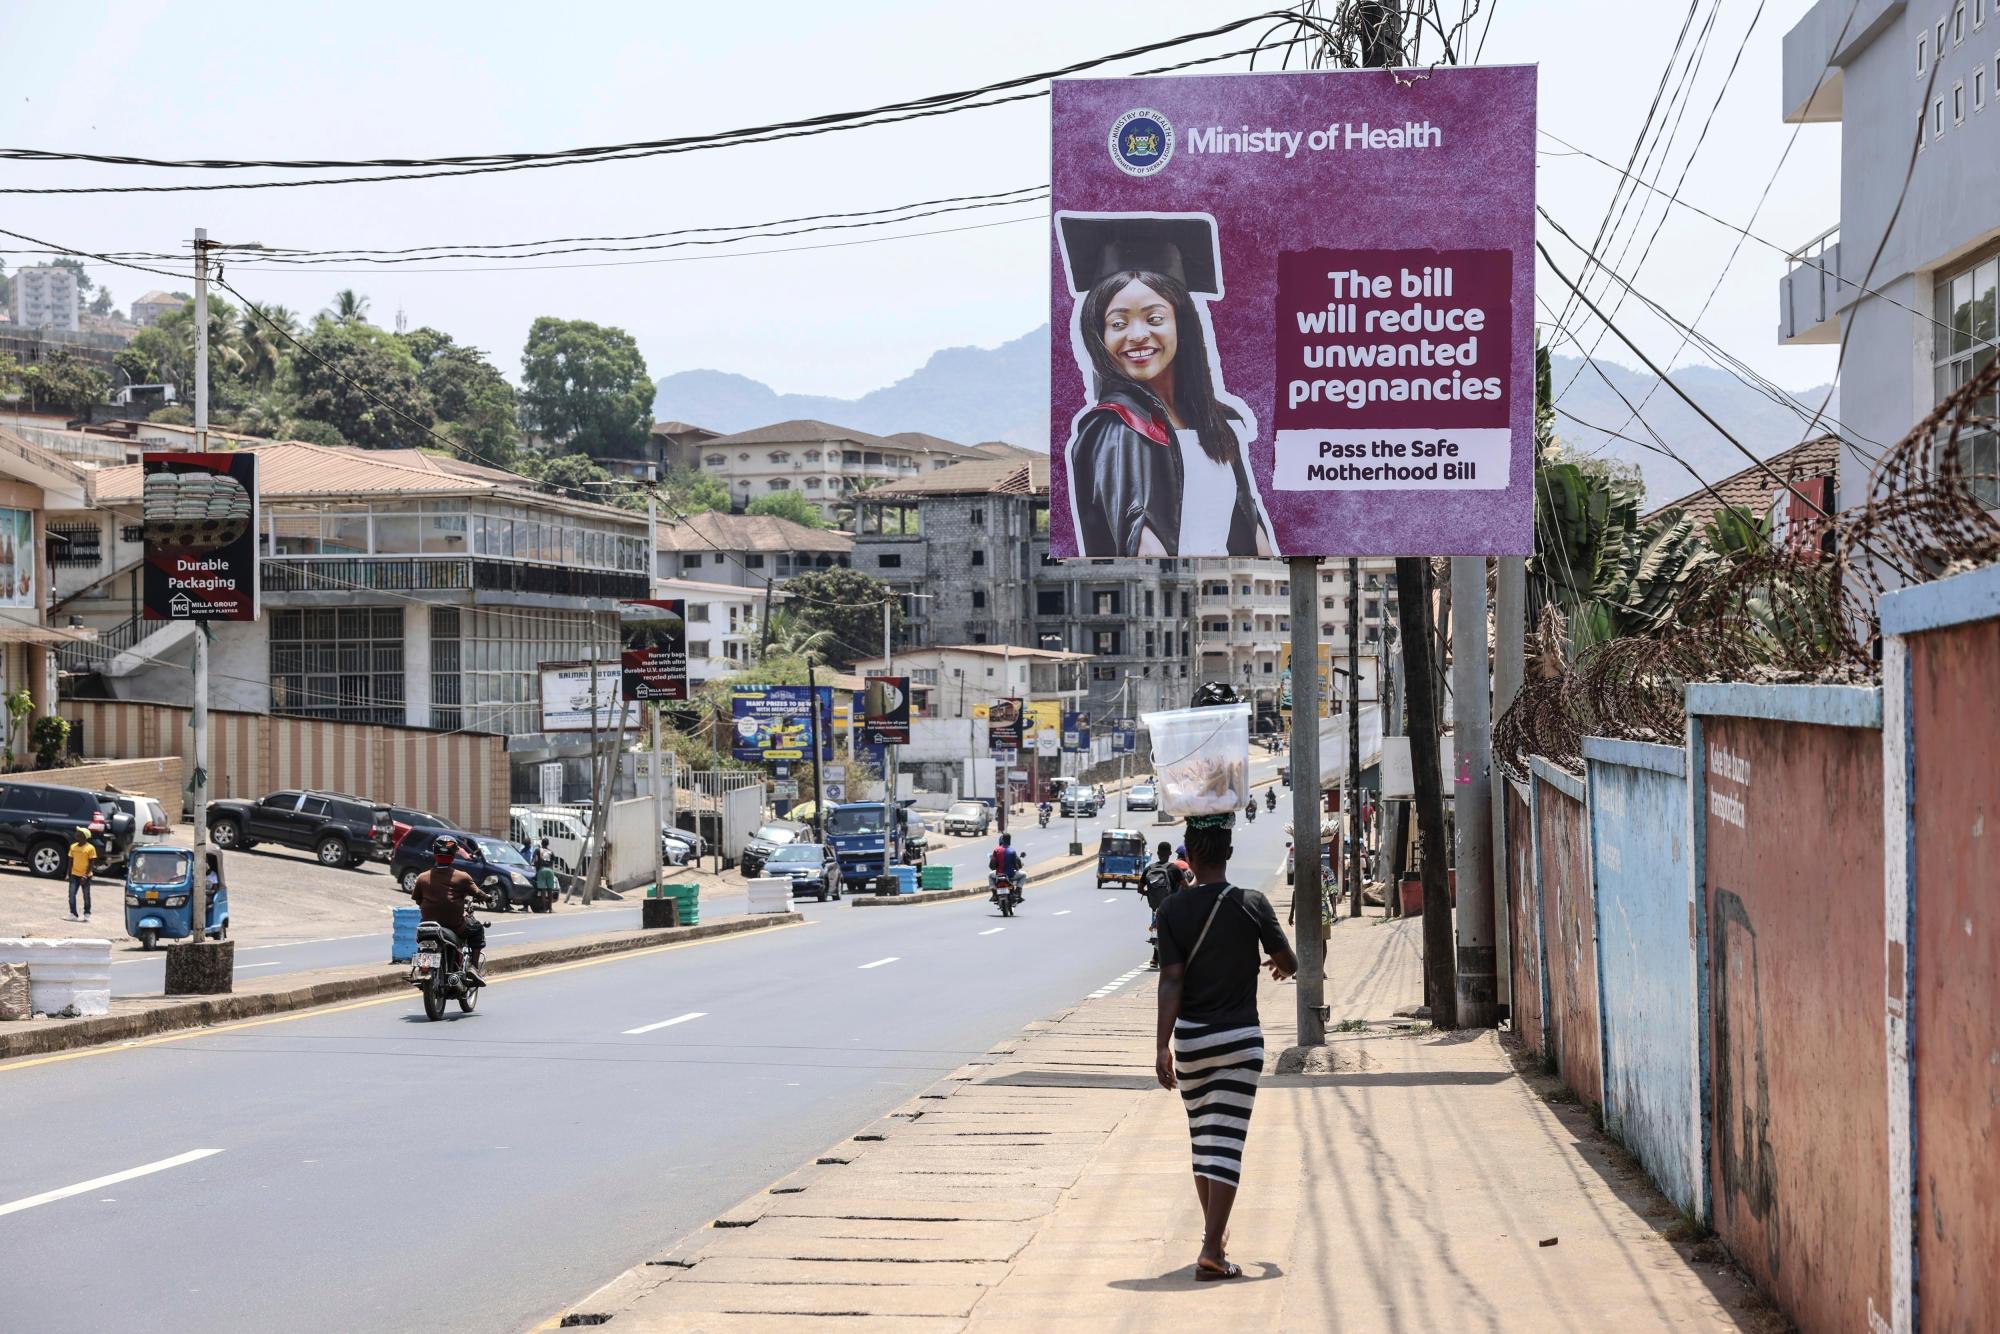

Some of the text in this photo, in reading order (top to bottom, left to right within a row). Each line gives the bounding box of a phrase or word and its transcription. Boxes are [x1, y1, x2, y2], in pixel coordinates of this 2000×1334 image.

[1112, 112, 1136, 138] MINISTRY
[1151, 113, 1172, 137] HEALTH
[1188, 121, 1442, 159] Ministry of Health
[1112, 143, 1137, 173] GOVERNMENT
[1146, 159, 1164, 173] SIERRA
[1162, 142, 1172, 161] LEONE
[1327, 266, 1453, 298] The bill
[1296, 302, 1486, 333] will reduce
[1303, 336, 1478, 368] unwanted
[1288, 369, 1502, 410] pregnancies
[1319, 438, 1459, 458] Pass the Safe
[1307, 461, 1476, 481] Motherhood Bill
[177, 559, 230, 572] Durable
[168, 576, 236, 591] Packaging
[173, 603, 188, 611] MG
